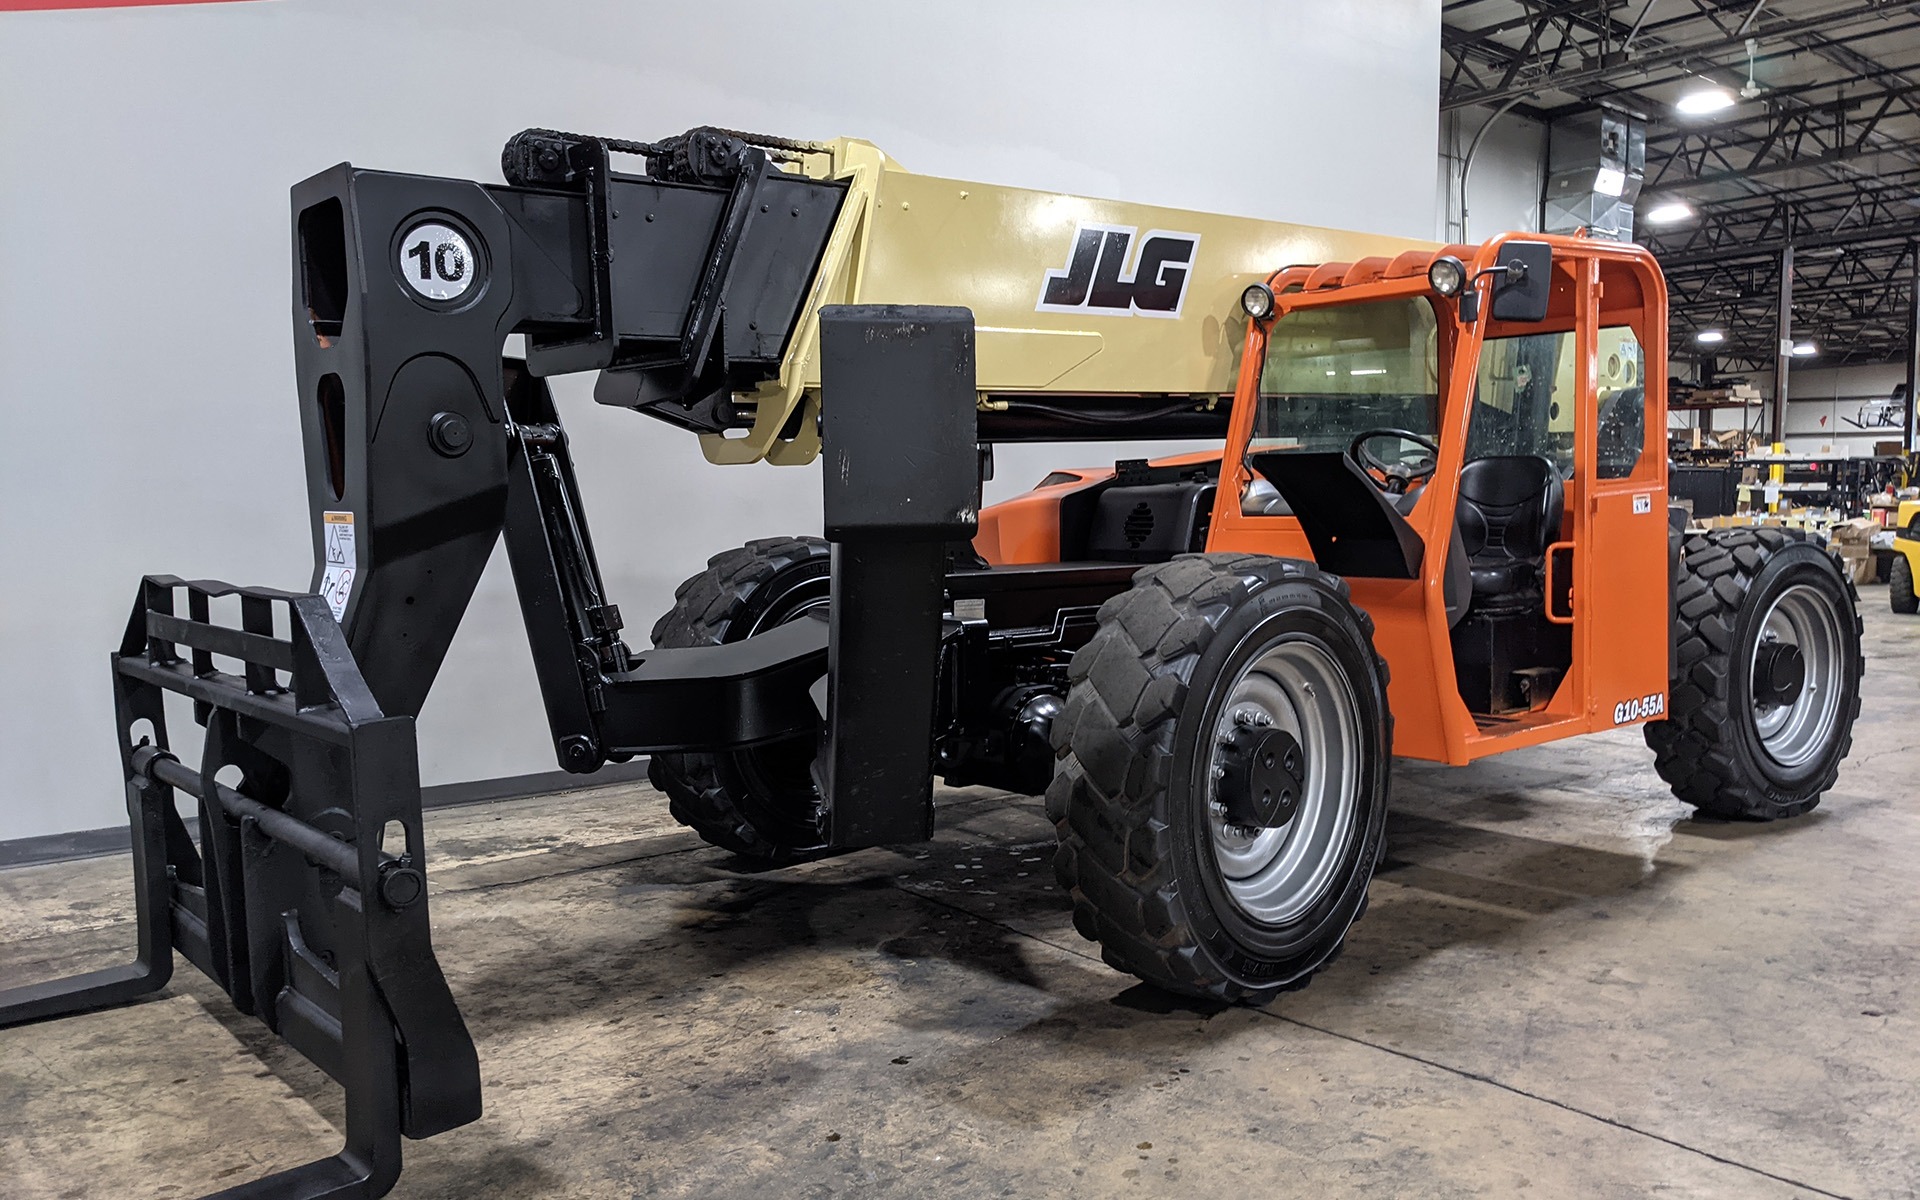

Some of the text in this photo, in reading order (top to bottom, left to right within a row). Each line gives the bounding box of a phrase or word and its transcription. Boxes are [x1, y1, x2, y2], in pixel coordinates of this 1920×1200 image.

[408, 240, 465, 282] 10
[1042, 227, 1195, 313] JLG
[1613, 692, 1664, 725] G10-55A
